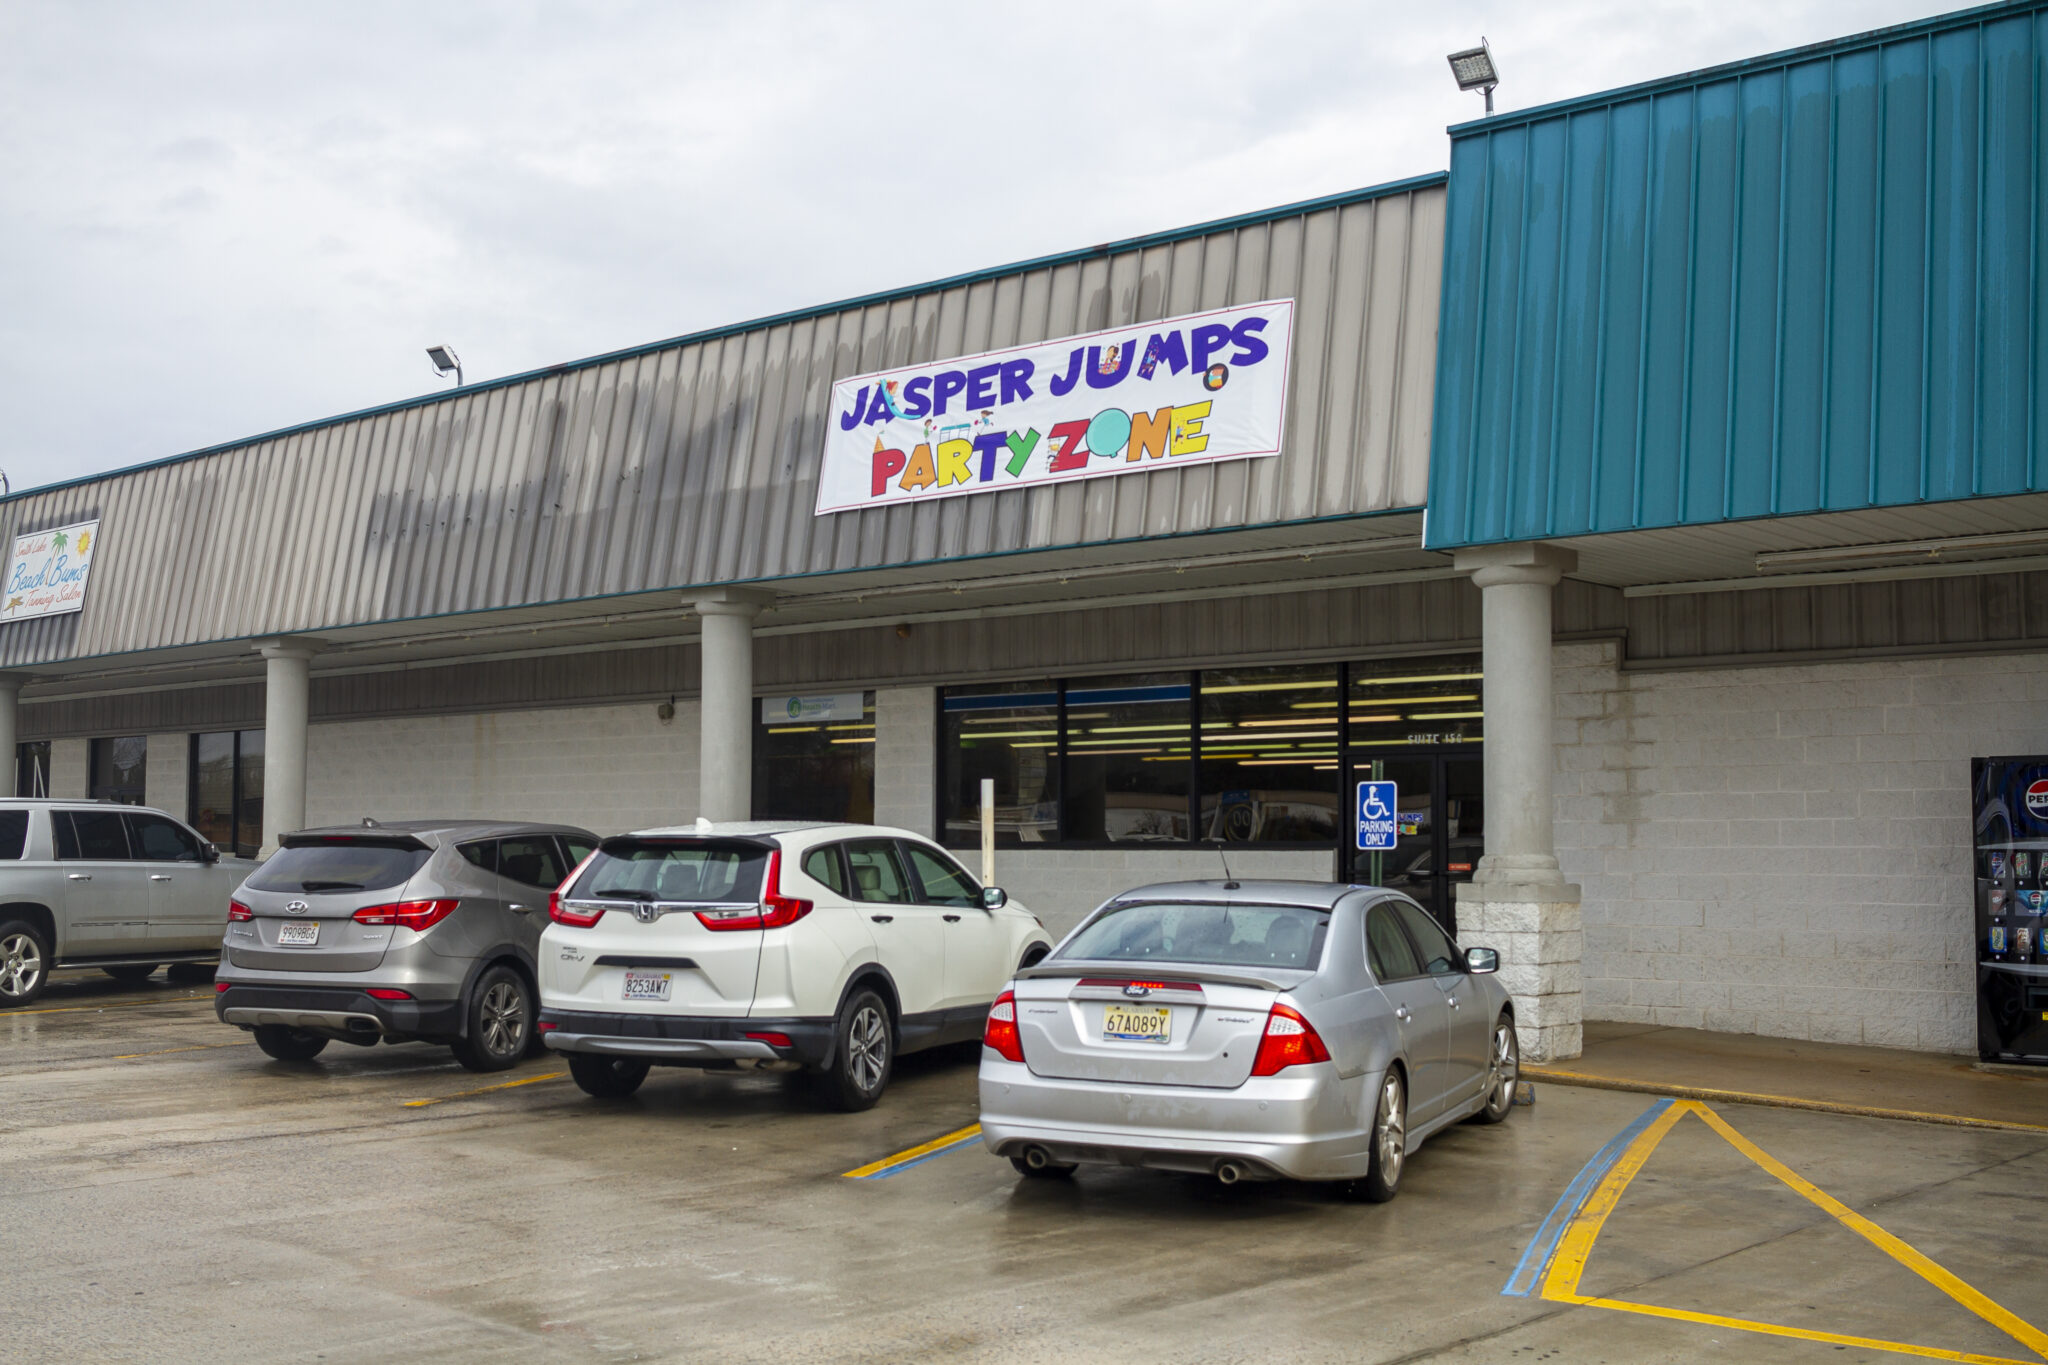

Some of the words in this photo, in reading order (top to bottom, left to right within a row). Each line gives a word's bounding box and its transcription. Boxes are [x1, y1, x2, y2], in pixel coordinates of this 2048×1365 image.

[841, 358, 1035, 431] JASPER
[1049, 317, 1269, 397] JUMPS
[871, 427, 1041, 498] PARTY
[1047, 399, 1213, 474] ZONE
[8, 558, 51, 594] Beach
[48, 555, 88, 587] Bums
[25, 589, 54, 611] Tanning
[56, 583, 81, 602] Salon
[1408, 734, 1440, 744] SUITE
[1360, 820, 1393, 833] PARKING
[1365, 833, 1387, 845] ONLY
[626, 979, 669, 994] 8253AW7
[1107, 1015, 1166, 1036] 67A089Y
